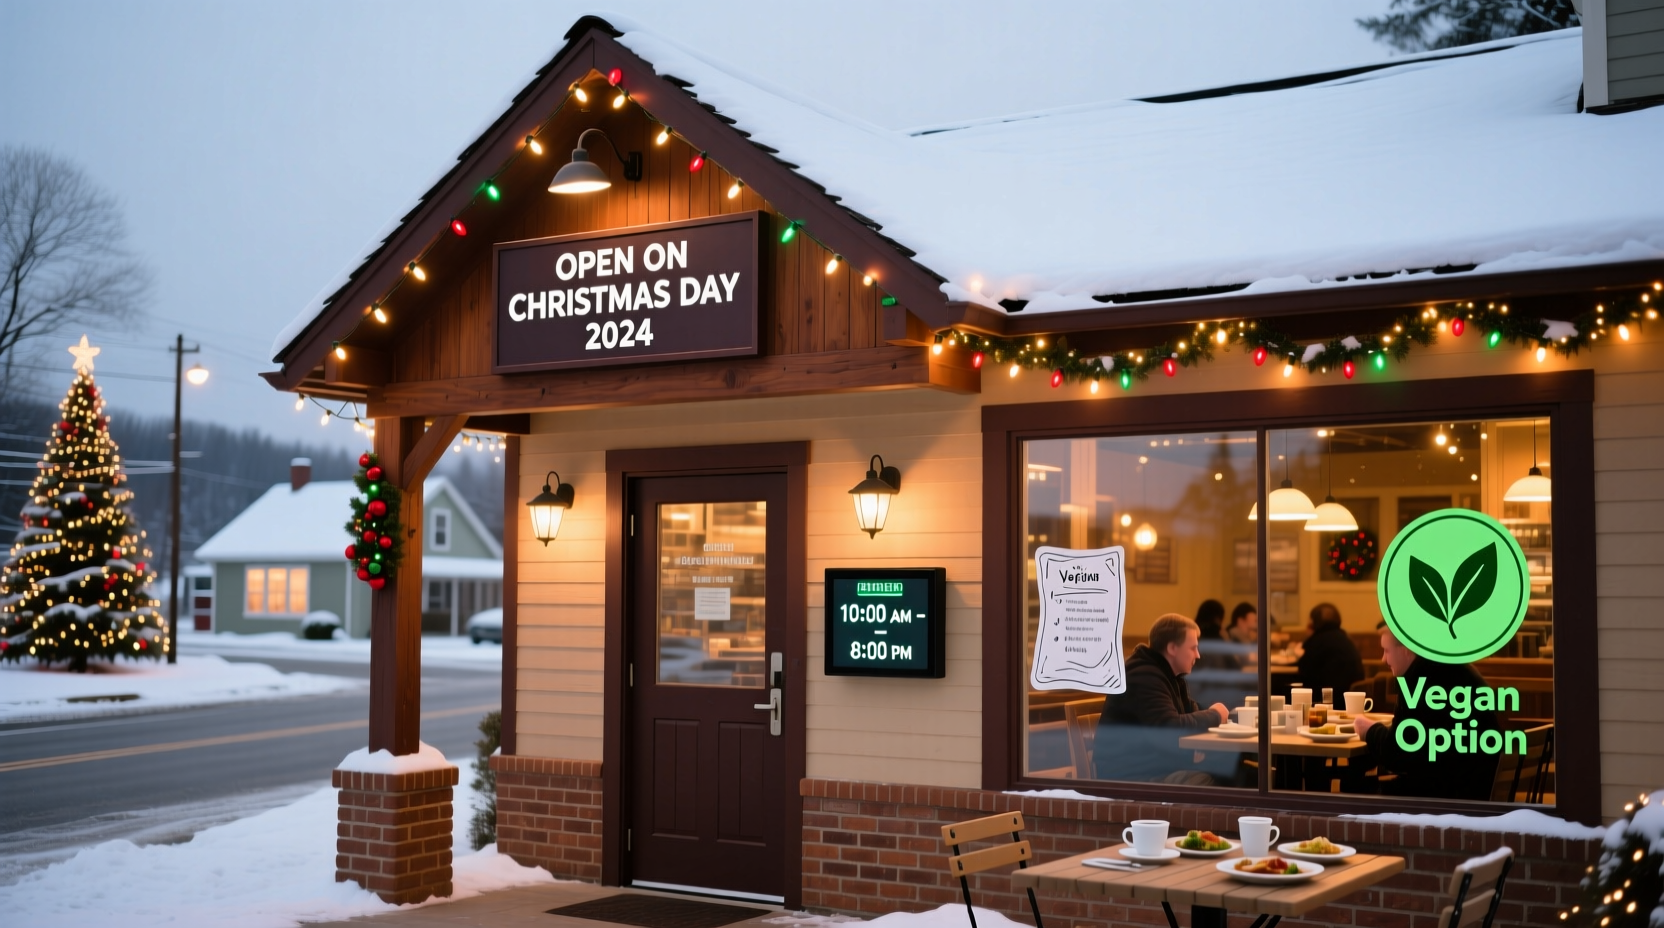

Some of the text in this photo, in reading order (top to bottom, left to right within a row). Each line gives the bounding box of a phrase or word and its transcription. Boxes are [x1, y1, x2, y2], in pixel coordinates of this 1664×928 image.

[556, 240, 688, 281] OPEN ON
[508, 272, 741, 322] CHRISTMAS DAY
[585, 318, 654, 350] 2024
[840, 603, 887, 623] 10:00
[889, 608, 912, 624] AM
[850, 640, 912, 660] 8:00 PM
[1396, 676, 1520, 720] Vegan
[1395, 718, 1527, 762] Option
